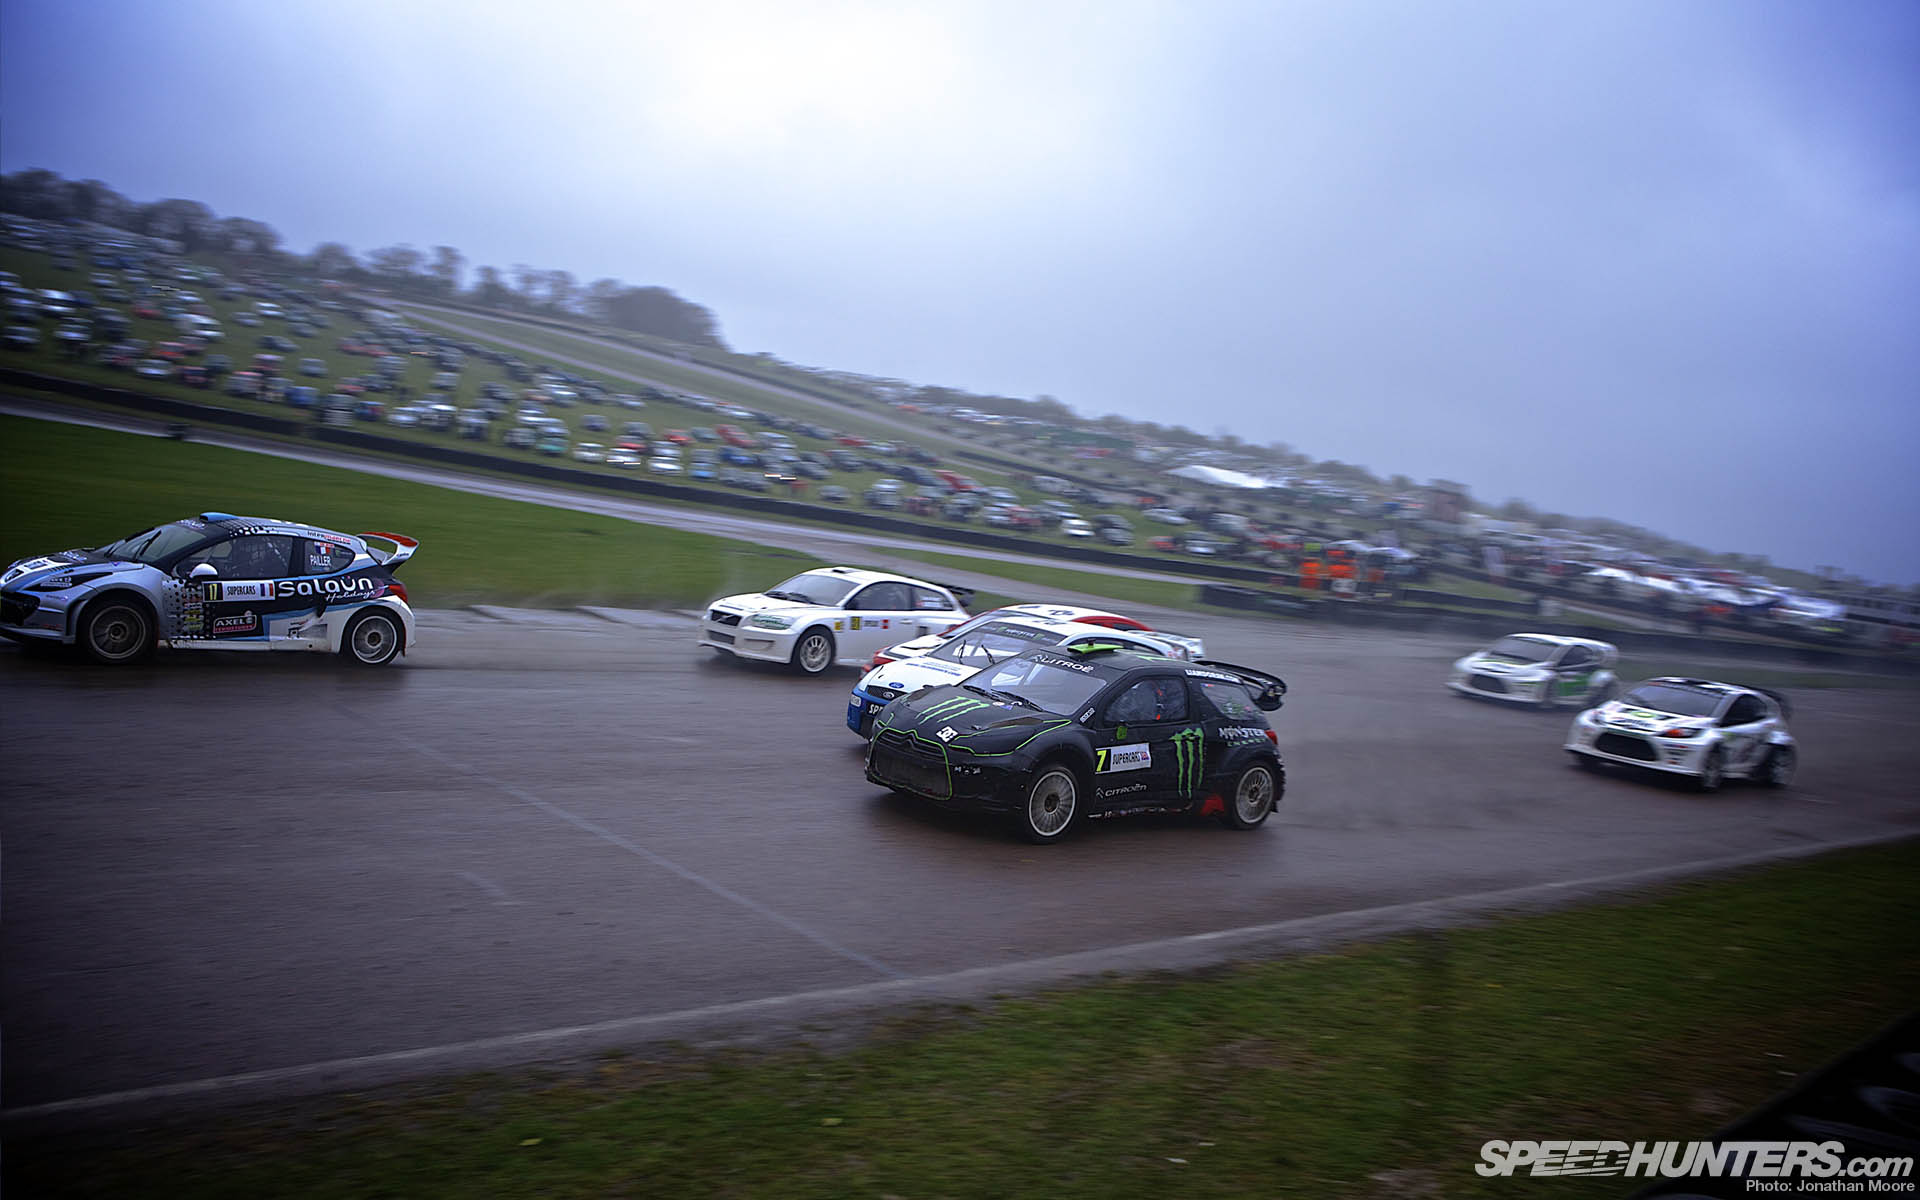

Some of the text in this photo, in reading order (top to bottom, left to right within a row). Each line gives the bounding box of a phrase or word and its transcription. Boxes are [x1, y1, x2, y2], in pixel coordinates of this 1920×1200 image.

[227, 585, 256, 596] SUPERCARS
[1096, 750, 1141, 772] 7 SUPERCARS
